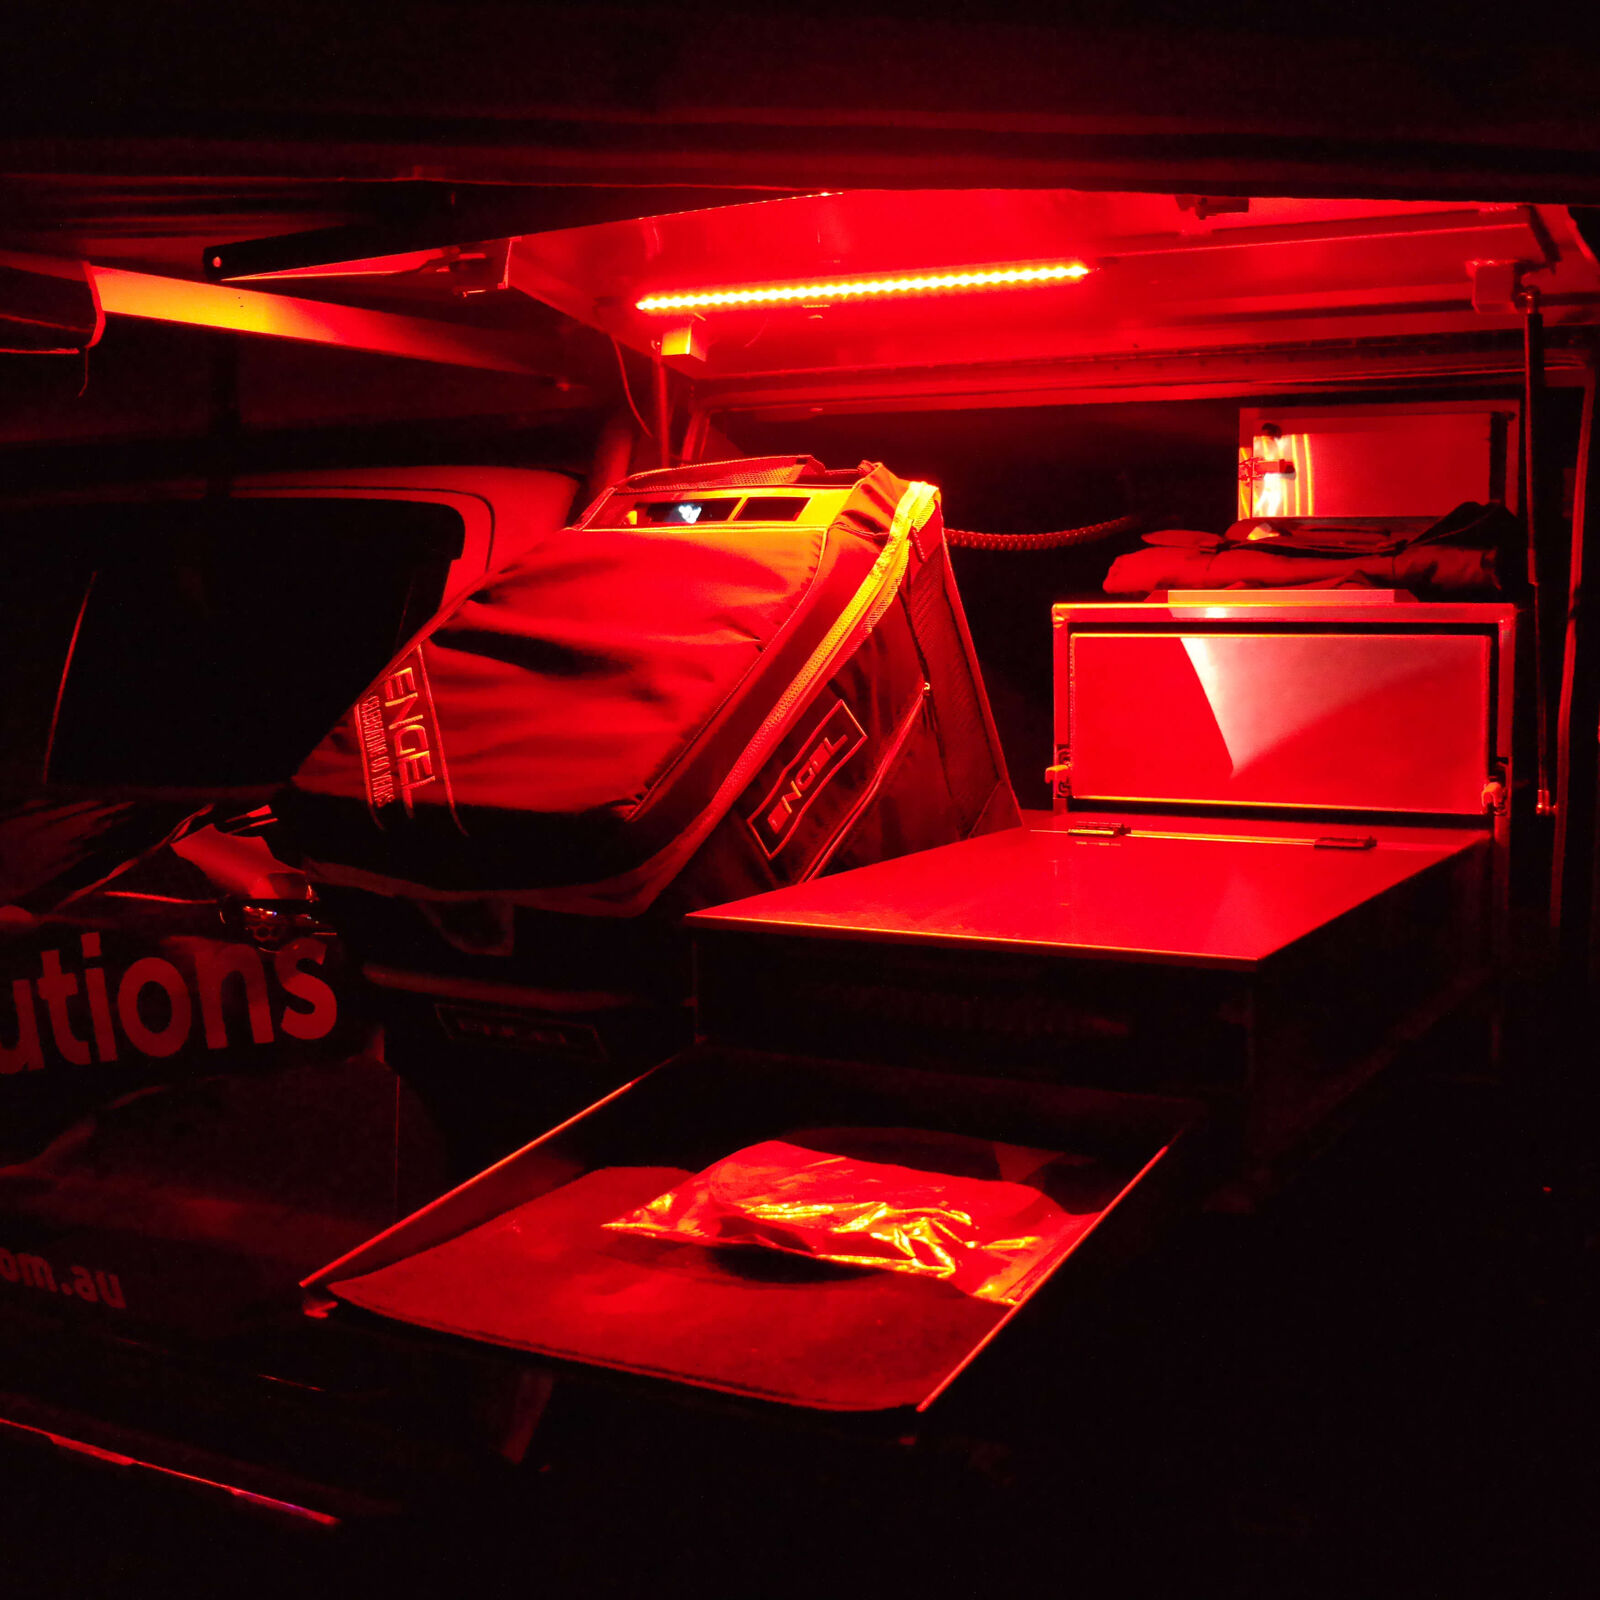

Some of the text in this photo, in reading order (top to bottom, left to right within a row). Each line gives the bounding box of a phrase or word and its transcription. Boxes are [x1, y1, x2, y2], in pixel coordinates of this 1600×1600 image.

[361, 695, 388, 757] CELEBRATING
[384, 667, 436, 819] ENGEL
[371, 770, 395, 808] YEARS
[767, 734, 848, 834] ENGEL
